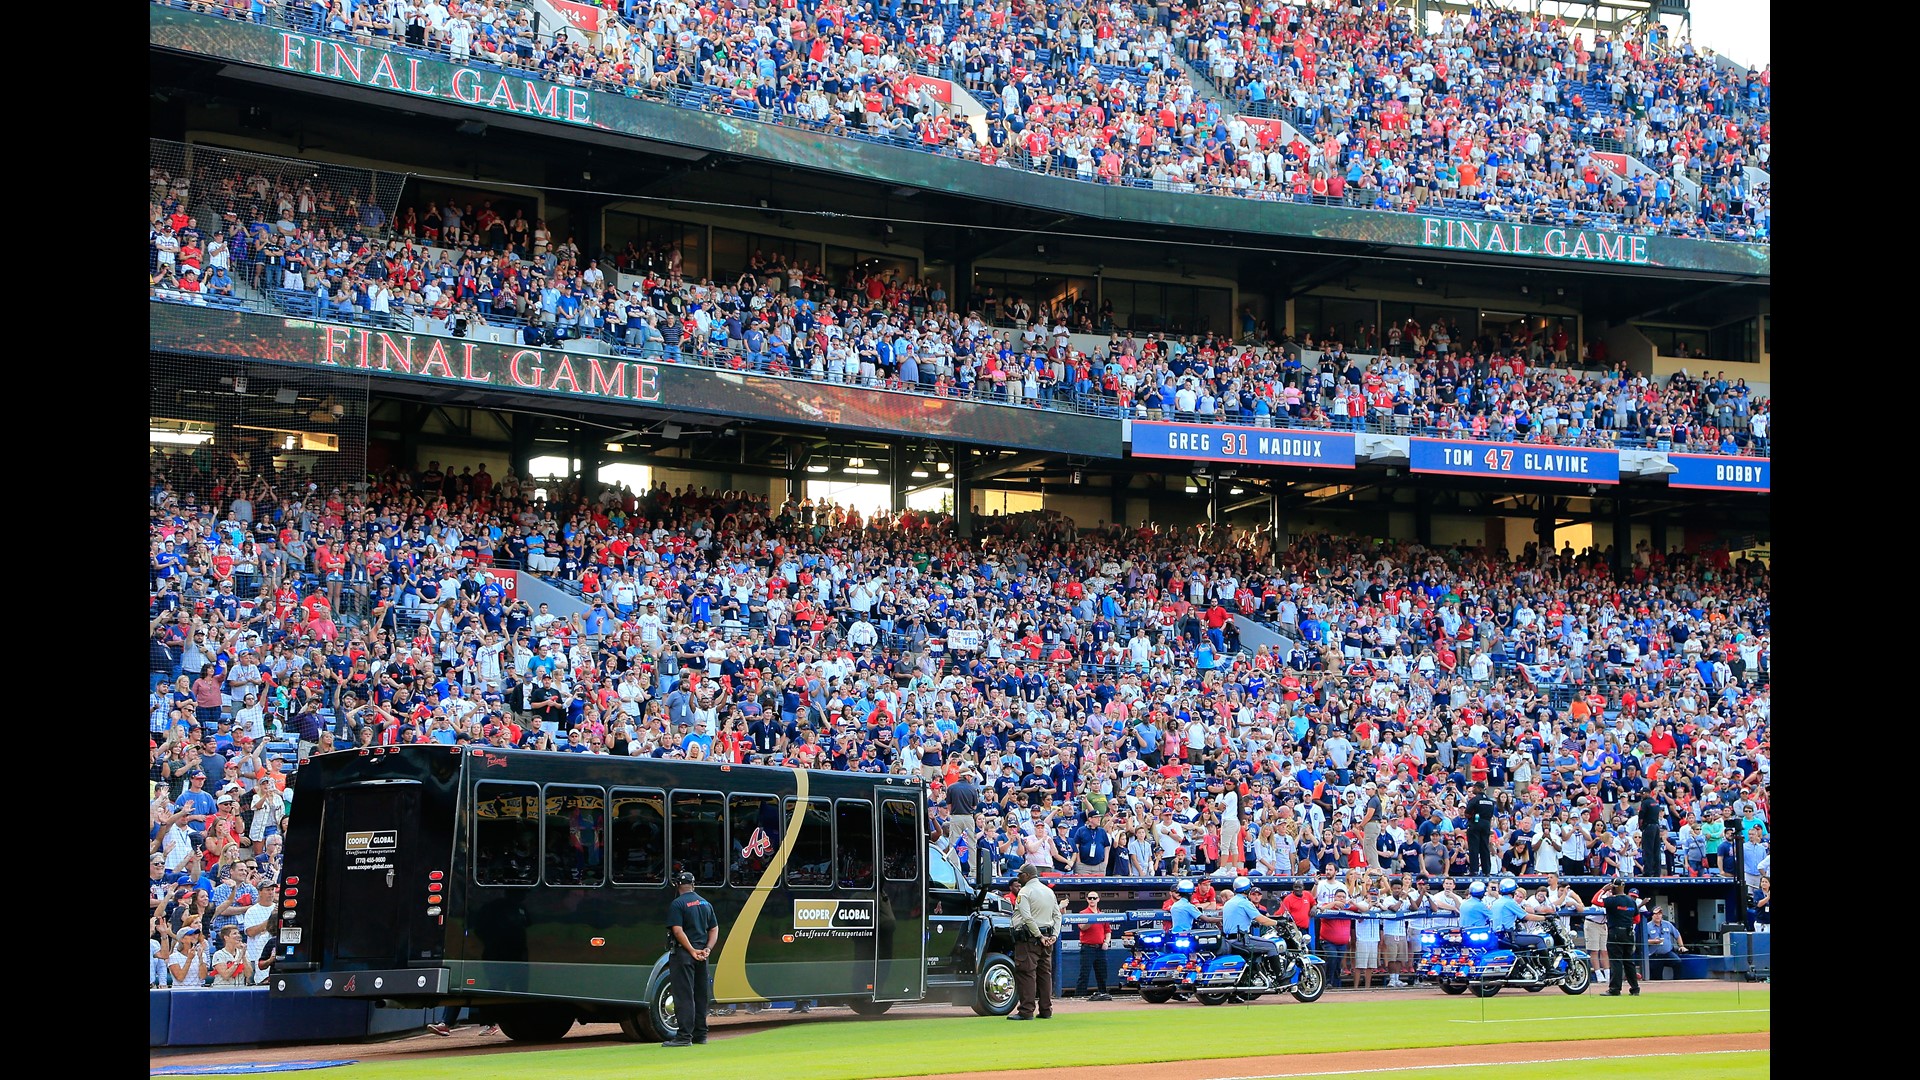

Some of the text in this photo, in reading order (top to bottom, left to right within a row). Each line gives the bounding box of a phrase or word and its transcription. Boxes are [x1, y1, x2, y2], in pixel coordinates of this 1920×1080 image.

[279, 32, 591, 124] FINAL GAME
[1422, 217, 1649, 265] FINAL GAME
[320, 325, 660, 401] FINAL GAME
[1168, 432, 1322, 458] GREG 31 MADDUX
[1443, 448, 1589, 473] TOM 47 GLAVINE
[1716, 464, 1762, 483] BOBBY
[962, 637, 977, 646] TED
[348, 836, 395, 845] COOPER GLOBAL
[797, 908, 871, 921] COOPER GLOBAL
[794, 929, 874, 939] Chauffeured Transportation
